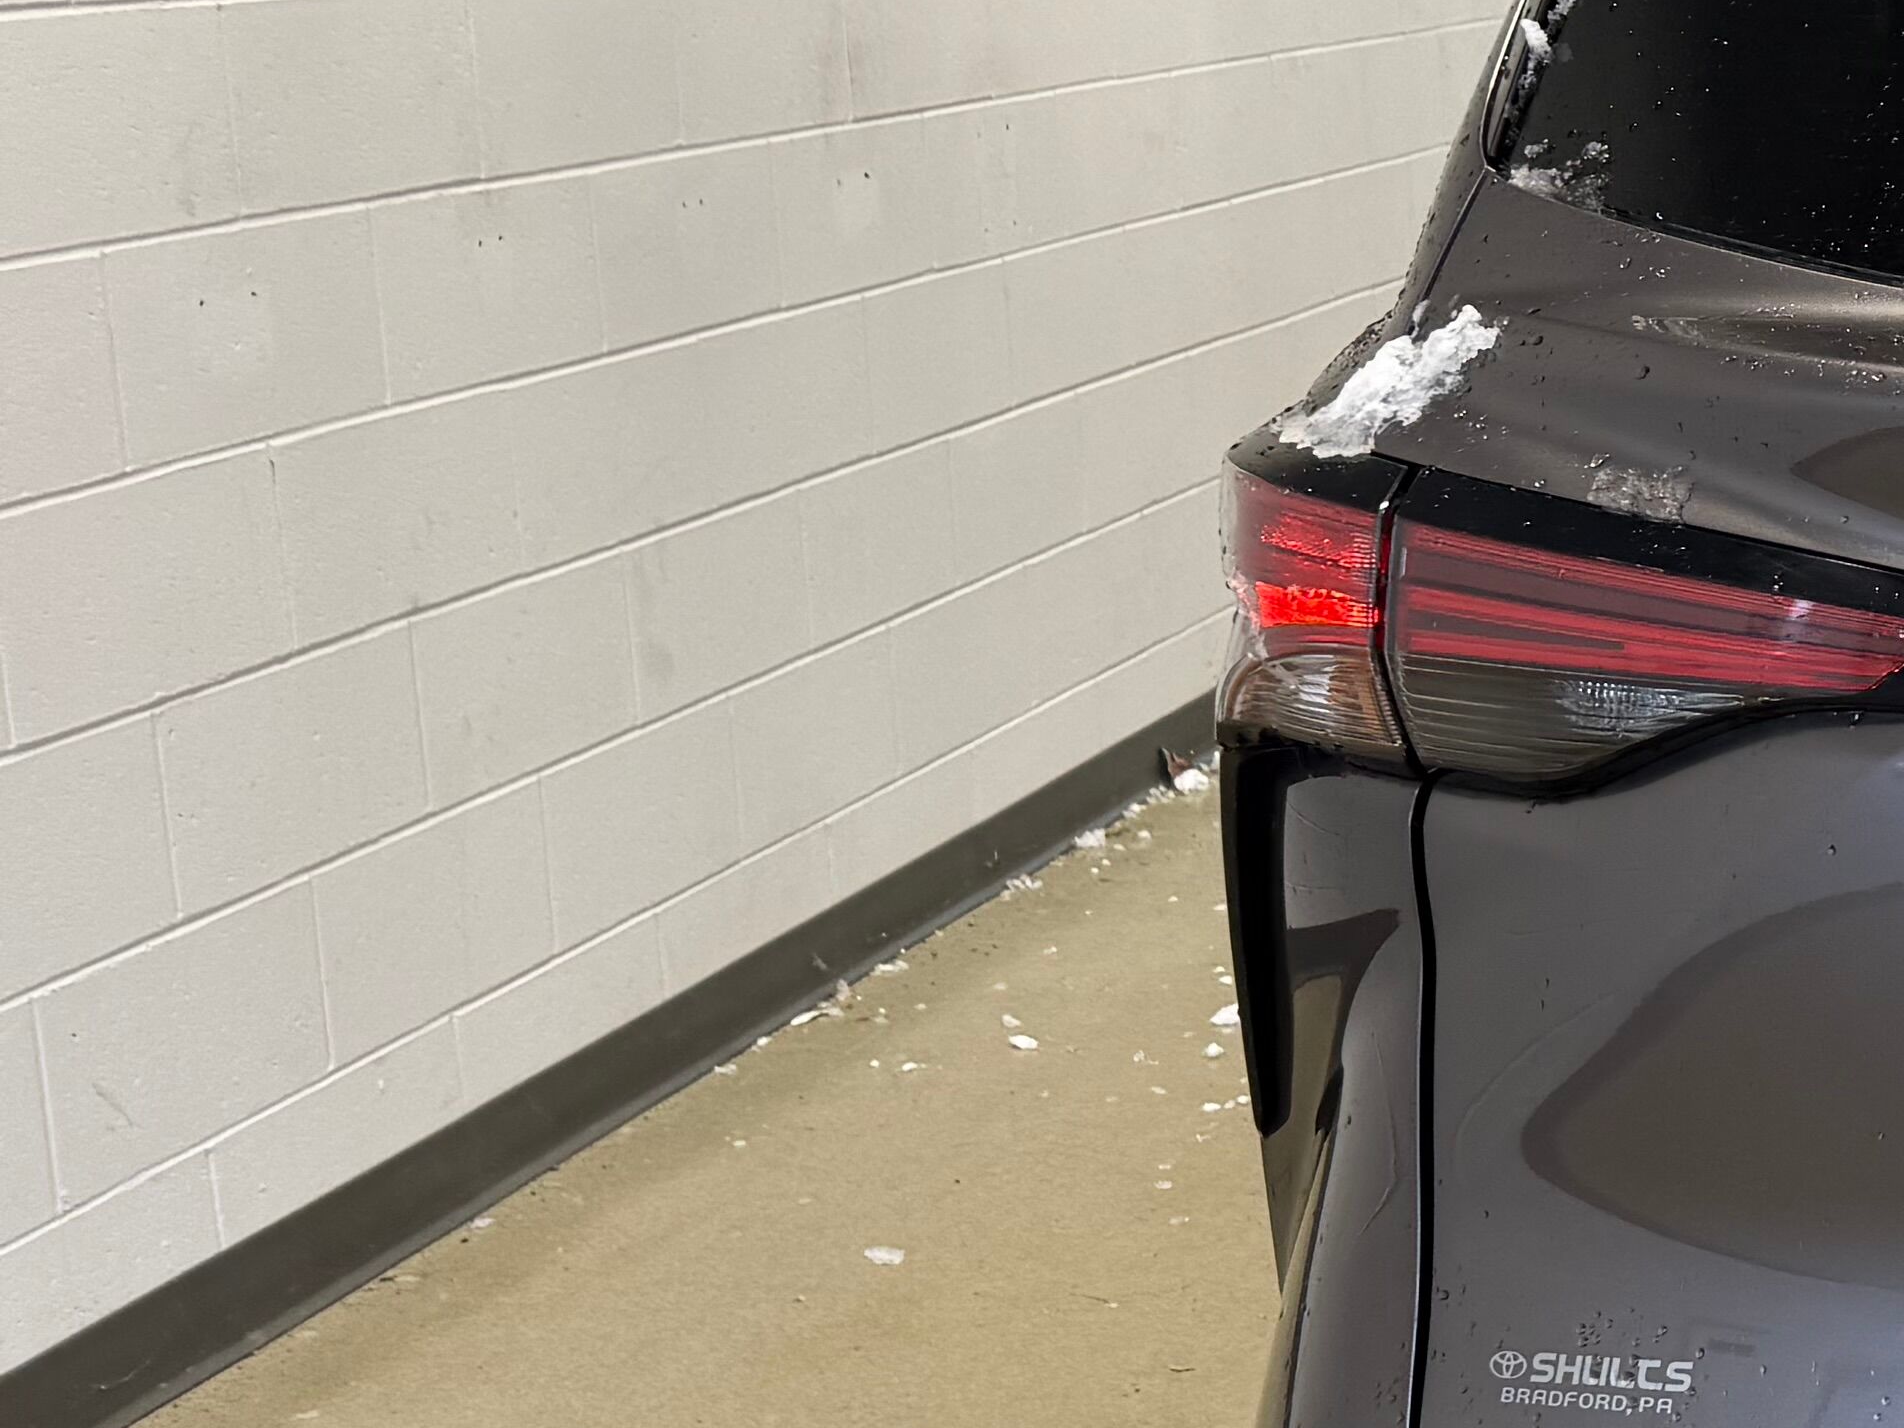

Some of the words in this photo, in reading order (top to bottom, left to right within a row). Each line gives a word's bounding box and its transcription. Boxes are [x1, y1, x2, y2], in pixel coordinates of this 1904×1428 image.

[1529, 1351, 1695, 1393] SHULTS
[1500, 1386, 1633, 1416] BRADFORD,
[1638, 1396, 1674, 1415] PA
